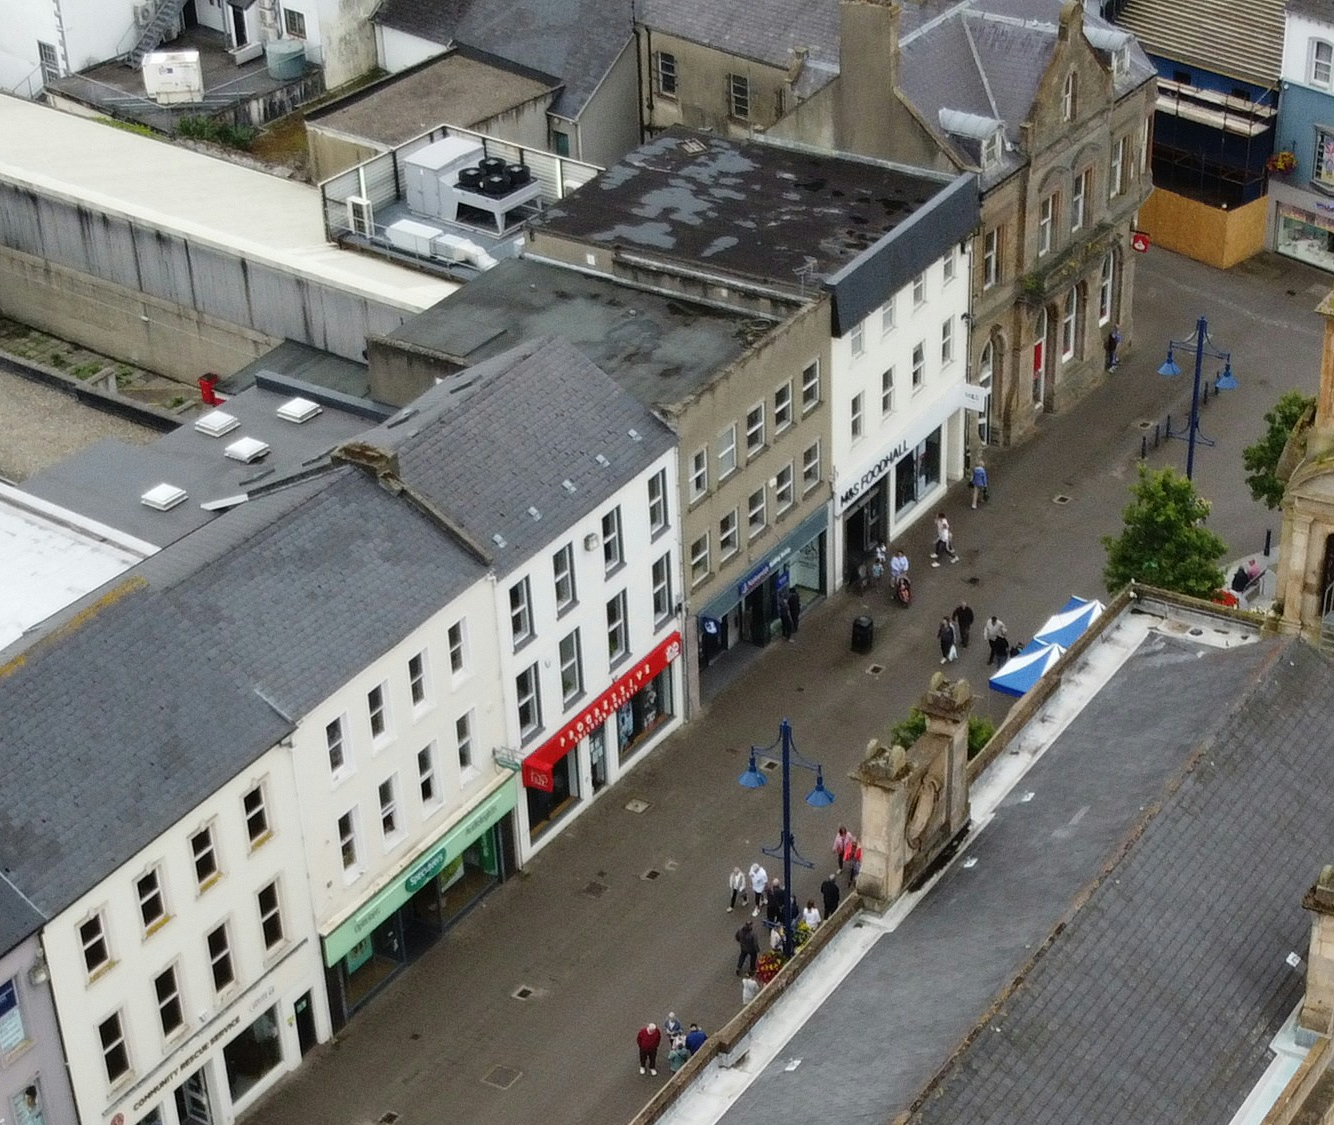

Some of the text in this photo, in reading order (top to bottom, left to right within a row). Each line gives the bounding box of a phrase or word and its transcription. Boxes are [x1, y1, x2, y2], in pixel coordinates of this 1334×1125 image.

[840, 439, 909, 507] M&S FOODHALL
[560, 664, 650, 747] PROGRESSIVE
[133, 1015, 241, 1111] COMMUNITY RESCUE SERVICE
